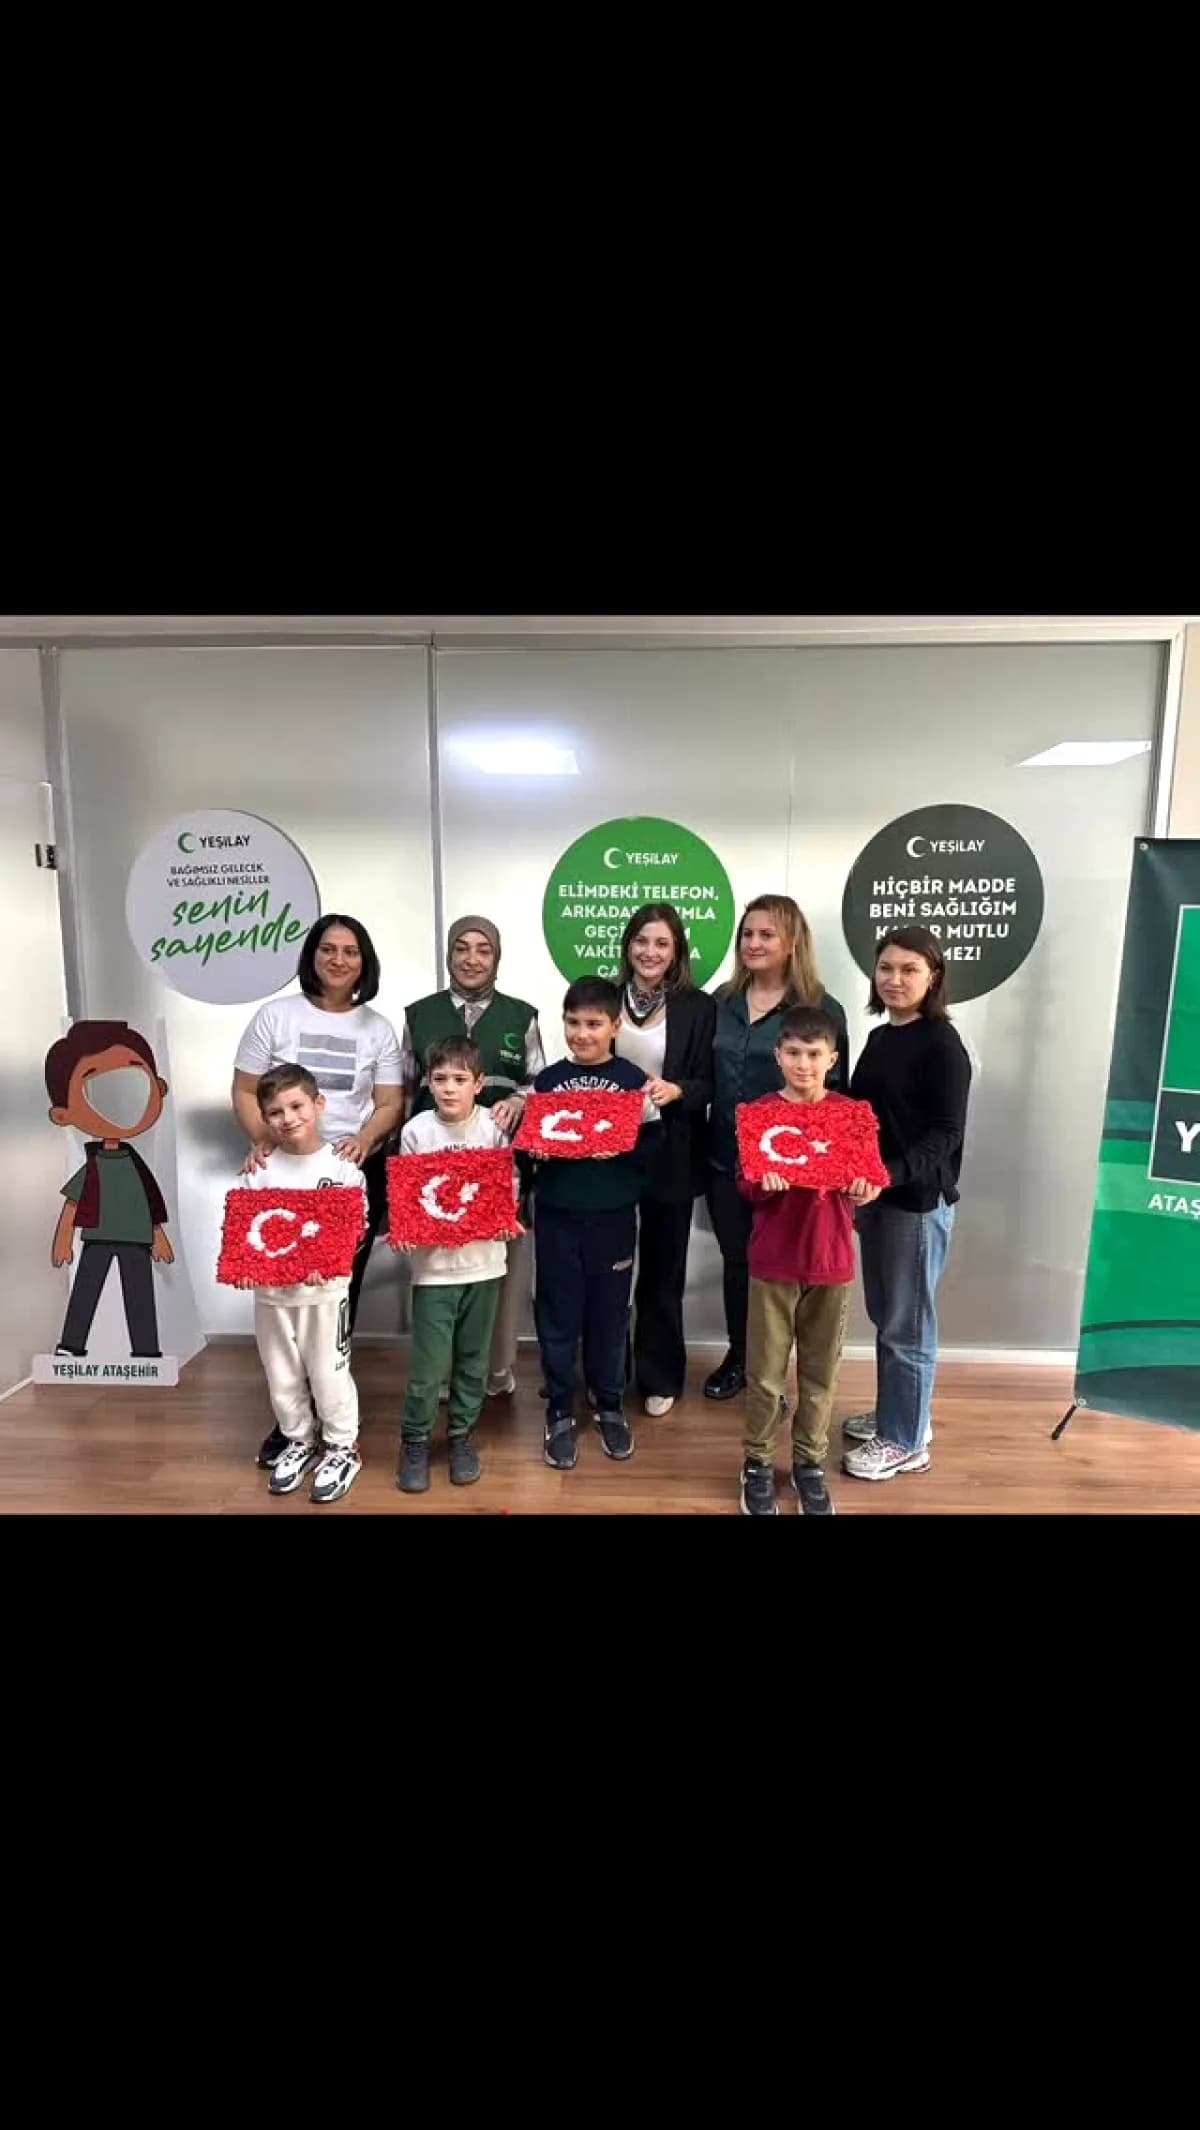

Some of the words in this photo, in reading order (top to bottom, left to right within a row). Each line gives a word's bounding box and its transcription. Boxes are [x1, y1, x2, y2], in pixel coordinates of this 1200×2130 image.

[199, 834, 250, 850] YEŞİLAY
[929, 839, 986, 855] YEŞİLAY
[625, 852, 679, 867] YEŞİLAY
[170, 863, 218, 875] BAĞIMSIZ
[220, 862, 264, 873] GELECEK
[167, 878, 180, 888] VE
[182, 876, 225, 887] SAĞLIKLI
[227, 874, 270, 886] NESİLLER
[558, 880, 639, 899] ELİMDEKİ
[873, 875, 944, 899] HİÇBİR
[948, 878, 1016, 894] MADDE
[172, 888, 269, 926] senin
[869, 898, 916, 918] BENİ
[920, 896, 1017, 916] SAĞLIĞIM
[150, 902, 309, 966] sayende
[947, 924, 1009, 939] MUTLU
[53, 1361, 99, 1379] YEŞİLAY
[102, 1362, 159, 1380] ATAŞEHİR
